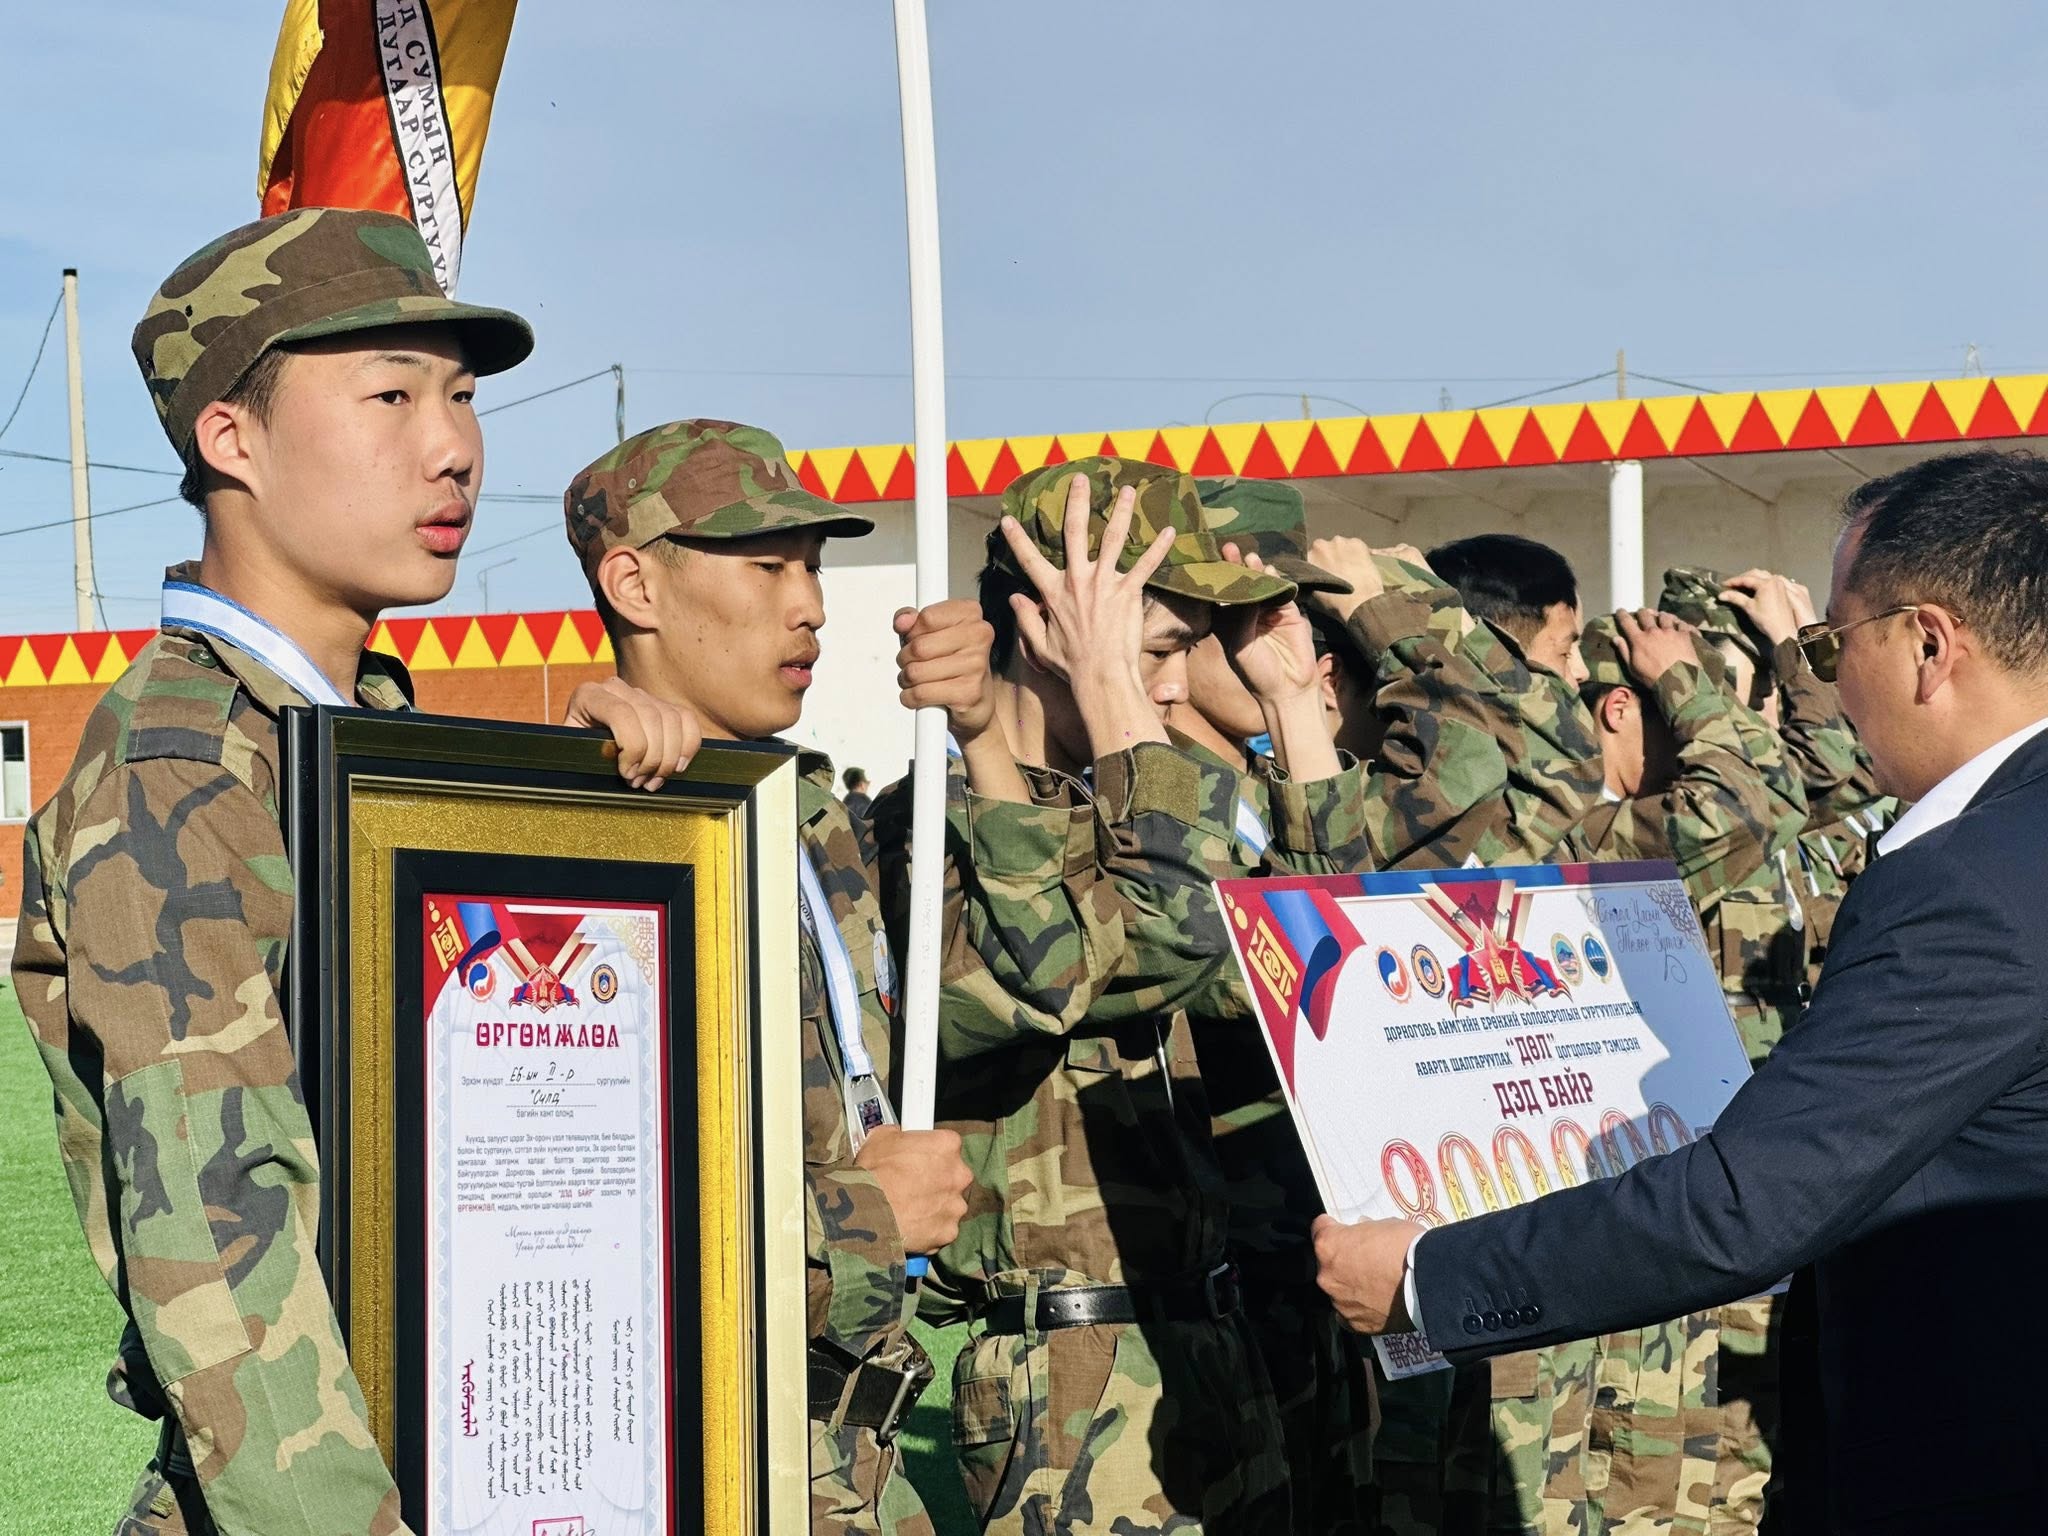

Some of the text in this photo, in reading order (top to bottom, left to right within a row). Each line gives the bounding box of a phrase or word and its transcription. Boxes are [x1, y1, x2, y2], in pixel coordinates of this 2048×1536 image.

[378, 12, 420, 132] ДУГААР
[395, 0, 448, 167] Д СУМЫН
[476, 1022, 619, 1047] ӨРГӨМЖЛӨЛ
[1384, 1001, 1642, 1042] ДОРНОГОВЬ АЙМГИЙН ЕРӨНХИЙ БОЛОВСРОЛЫН СУРГУУЛИУДЫН
[1415, 1061, 1450, 1076] АВАРГА
[1451, 1051, 1512, 1072] ШАЛГАРУУЛАХ
[1555, 1044, 1601, 1060] ЦОГЦОЛБОР
[1602, 1037, 1640, 1055] ТЭМЦЭЭН
[1493, 1067, 1594, 1119] ДЭД БАЙР
